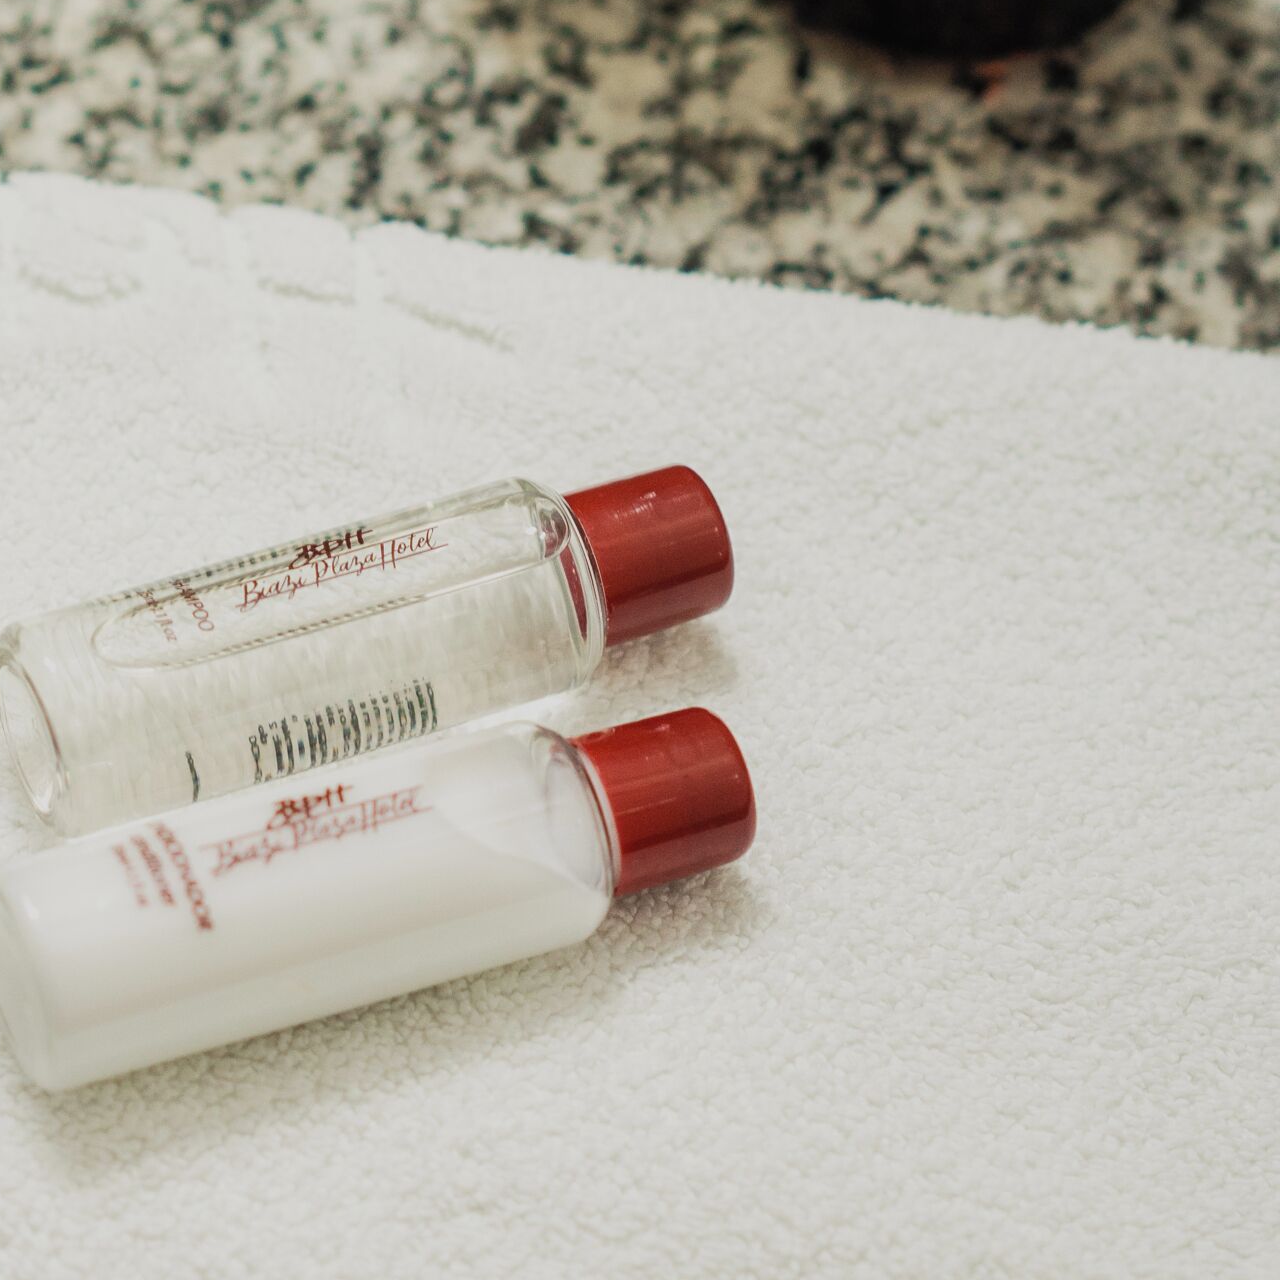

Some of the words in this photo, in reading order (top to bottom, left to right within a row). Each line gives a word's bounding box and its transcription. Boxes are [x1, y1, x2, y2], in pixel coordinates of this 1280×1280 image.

[235, 572, 308, 612] Biazi
[312, 551, 376, 587] Plaza
[380, 528, 438, 570] Hotel
